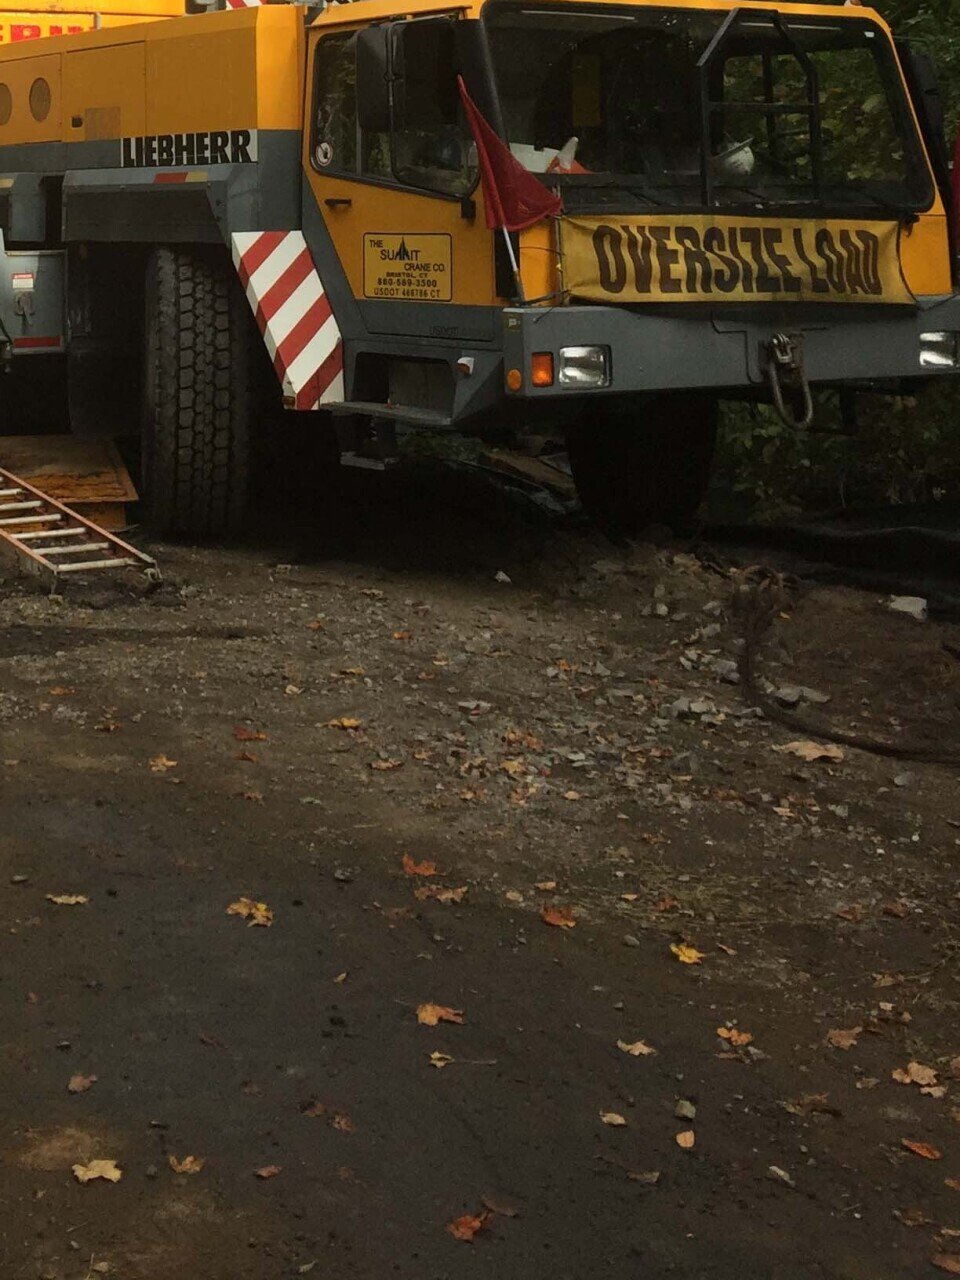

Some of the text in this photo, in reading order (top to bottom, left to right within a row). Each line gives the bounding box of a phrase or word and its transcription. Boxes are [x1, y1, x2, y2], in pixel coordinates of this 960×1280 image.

[123, 129, 252, 168] LIEBHERR
[369, 240, 383, 248] THE
[592, 225, 883, 295] OVERSIZE LOAD
[404, 263, 431, 272] CRANE
[374, 287, 400, 297] USDOT
